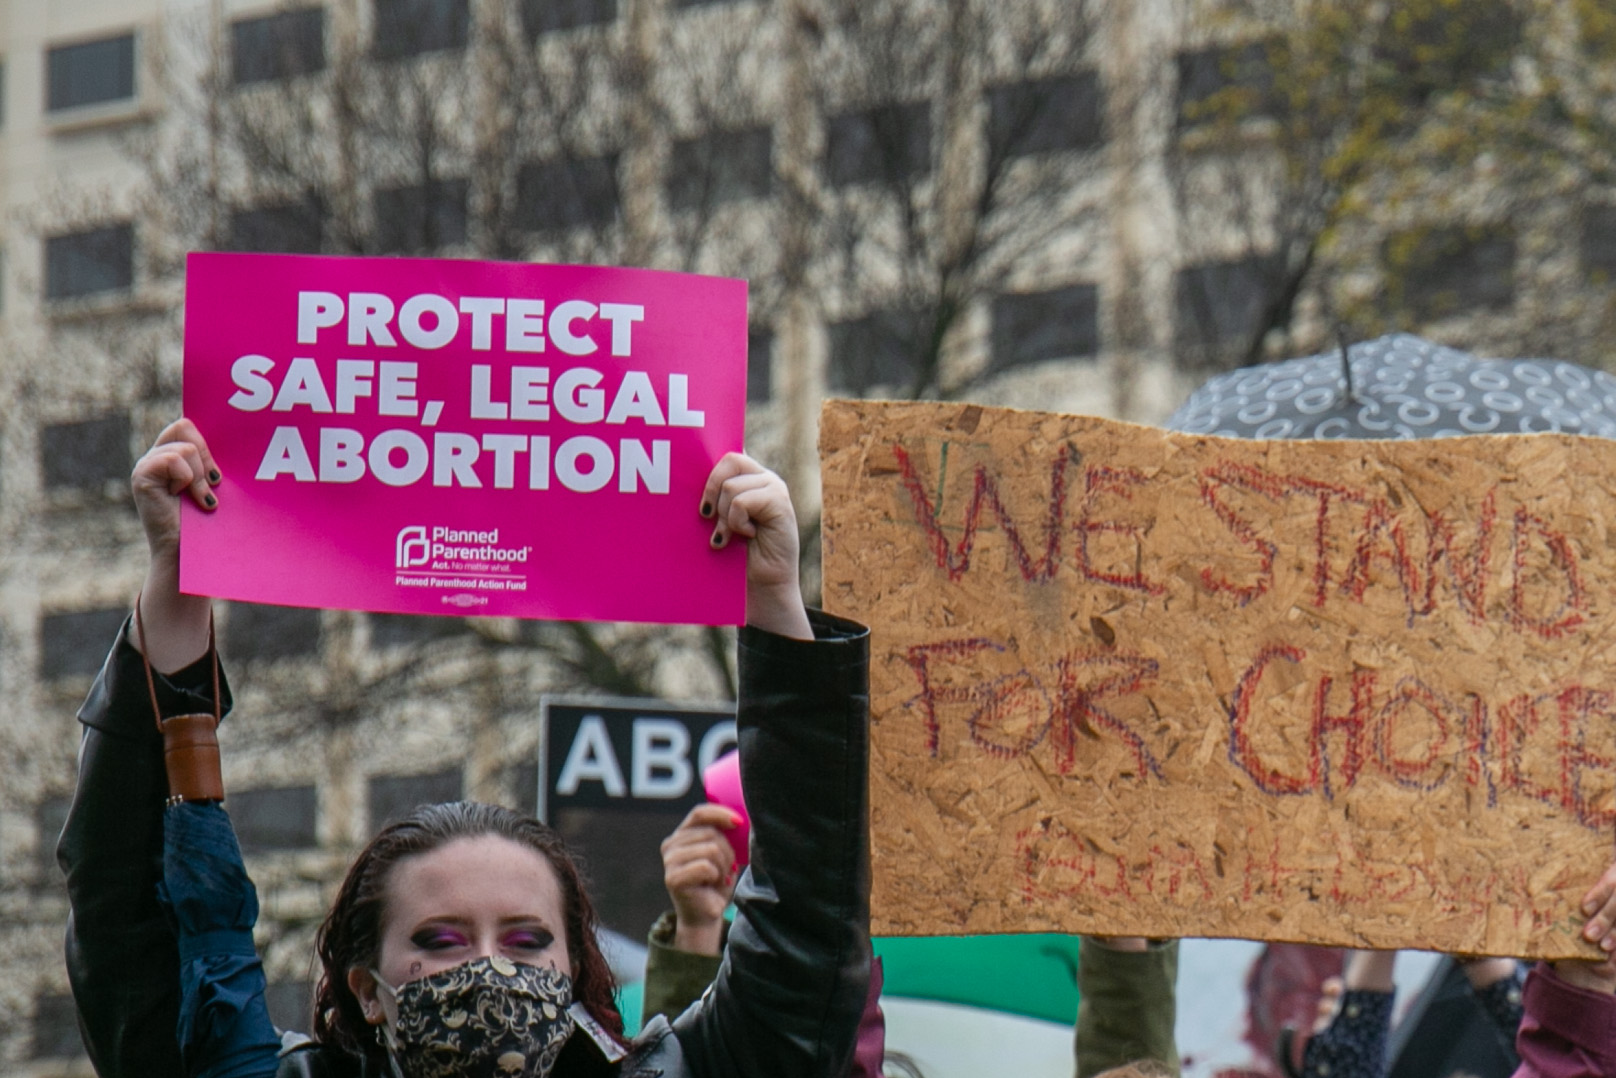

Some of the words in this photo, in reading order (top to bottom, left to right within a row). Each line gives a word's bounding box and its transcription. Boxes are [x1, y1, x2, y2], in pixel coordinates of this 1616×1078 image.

[297, 291, 644, 357] PROTECT
[227, 354, 445, 426] SAFE,
[470, 364, 705, 427] LEGAL
[254, 426, 671, 494] ABORTION
[432, 526, 499, 544] Planned
[432, 560, 450, 570] Act.
[451, 561, 463, 570] No
[464, 562, 489, 571] matter
[893, 445, 1166, 597] WE
[1200, 459, 1588, 639] STAND
[396, 576, 428, 587] Planned
[430, 577, 476, 588] Parenthood
[478, 579, 504, 589] Action
[506, 580, 527, 590] Fund
[903, 637, 1169, 787] FOR
